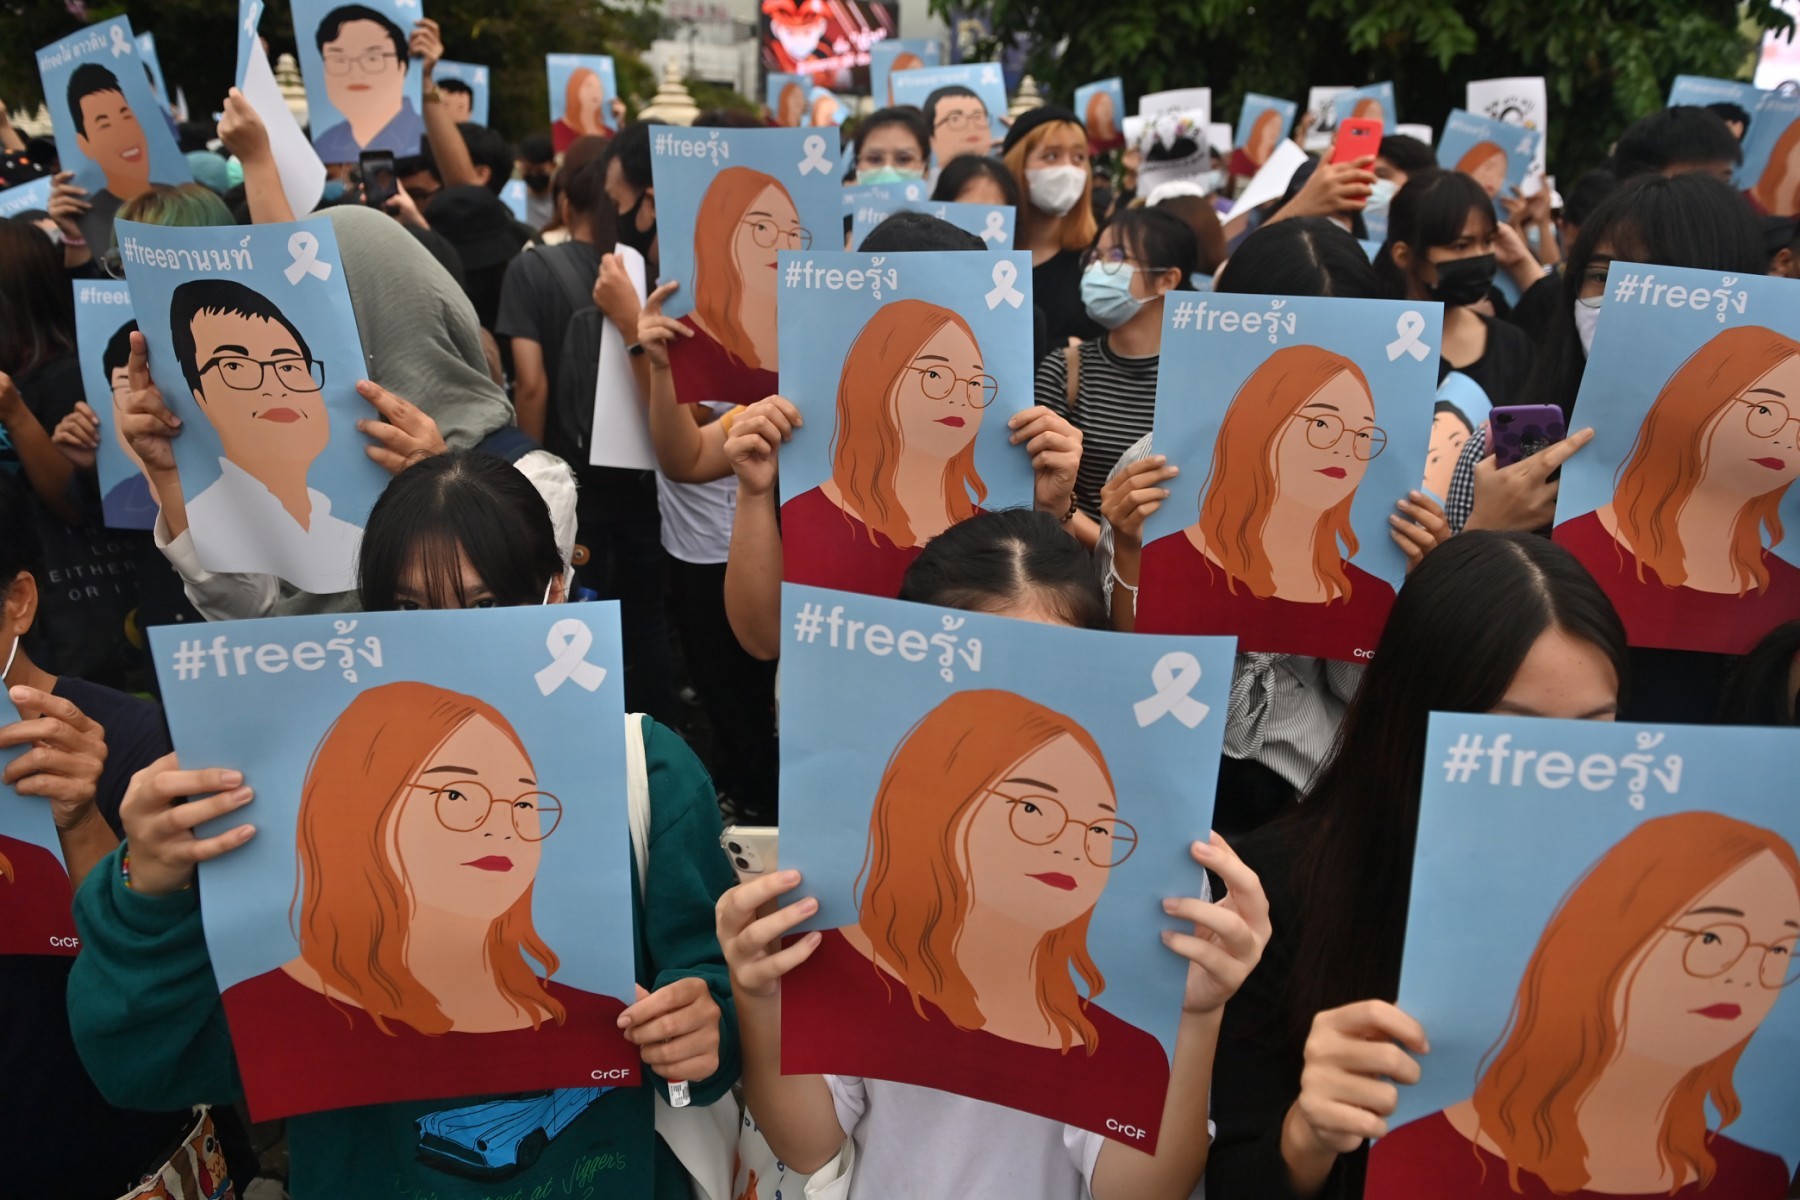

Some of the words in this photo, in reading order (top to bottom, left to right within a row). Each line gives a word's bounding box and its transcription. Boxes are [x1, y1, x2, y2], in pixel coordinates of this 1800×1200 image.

[655, 130, 729, 167] #freeรุ้ง
[124, 234, 254, 272] #freeอานนท์
[784, 256, 898, 300] #freeรุ้ง
[1614, 273, 1748, 323] #freeรุ้ง
[1172, 299, 1297, 344] #freeรุ้ง
[49, 560, 138, 584] EITHER
[68, 585, 100, 601] OR
[172, 619, 383, 683] #freeรุ้ง
[794, 602, 982, 683] #freeรุ้ง
[1443, 731, 1683, 810] #freeรุ้ง
[49, 936, 80, 948] CrCF
[590, 1068, 630, 1080] CrCF
[1105, 1118, 1147, 1141] CrCF
